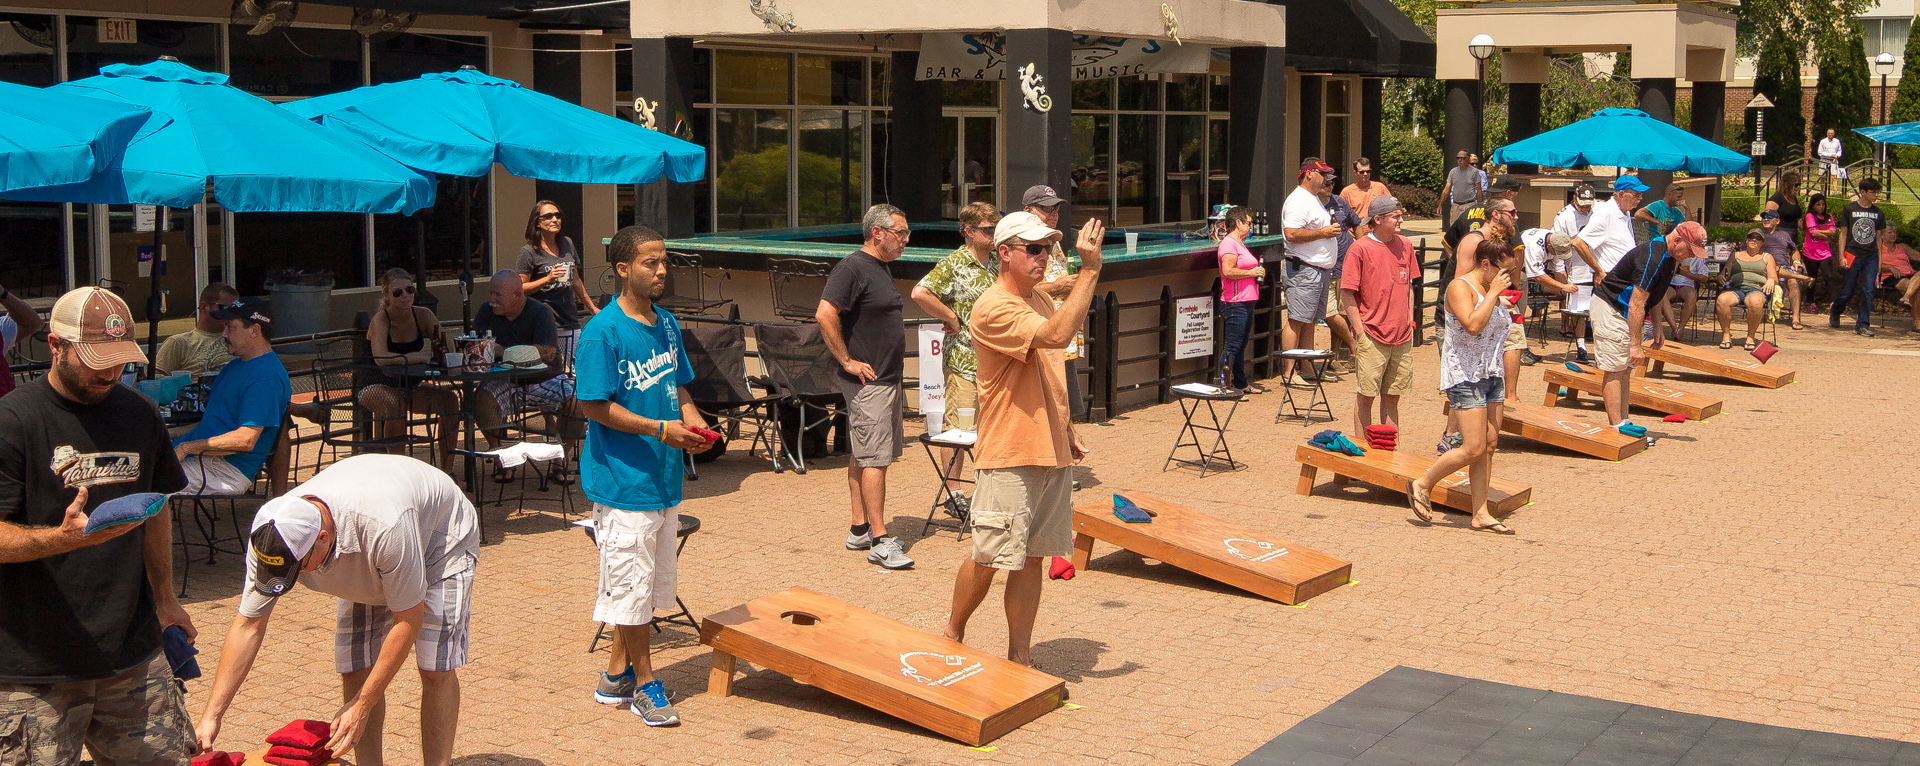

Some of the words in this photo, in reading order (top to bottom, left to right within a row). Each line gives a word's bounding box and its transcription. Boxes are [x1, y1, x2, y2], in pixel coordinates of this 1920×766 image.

[106, 20, 131, 40] EXIT
[926, 66, 961, 79] BAR
[975, 68, 985, 80] &
[1076, 62, 1144, 79] MUSIC
[924, 383, 941, 391] Beach
[273, 583, 285, 593] 9
